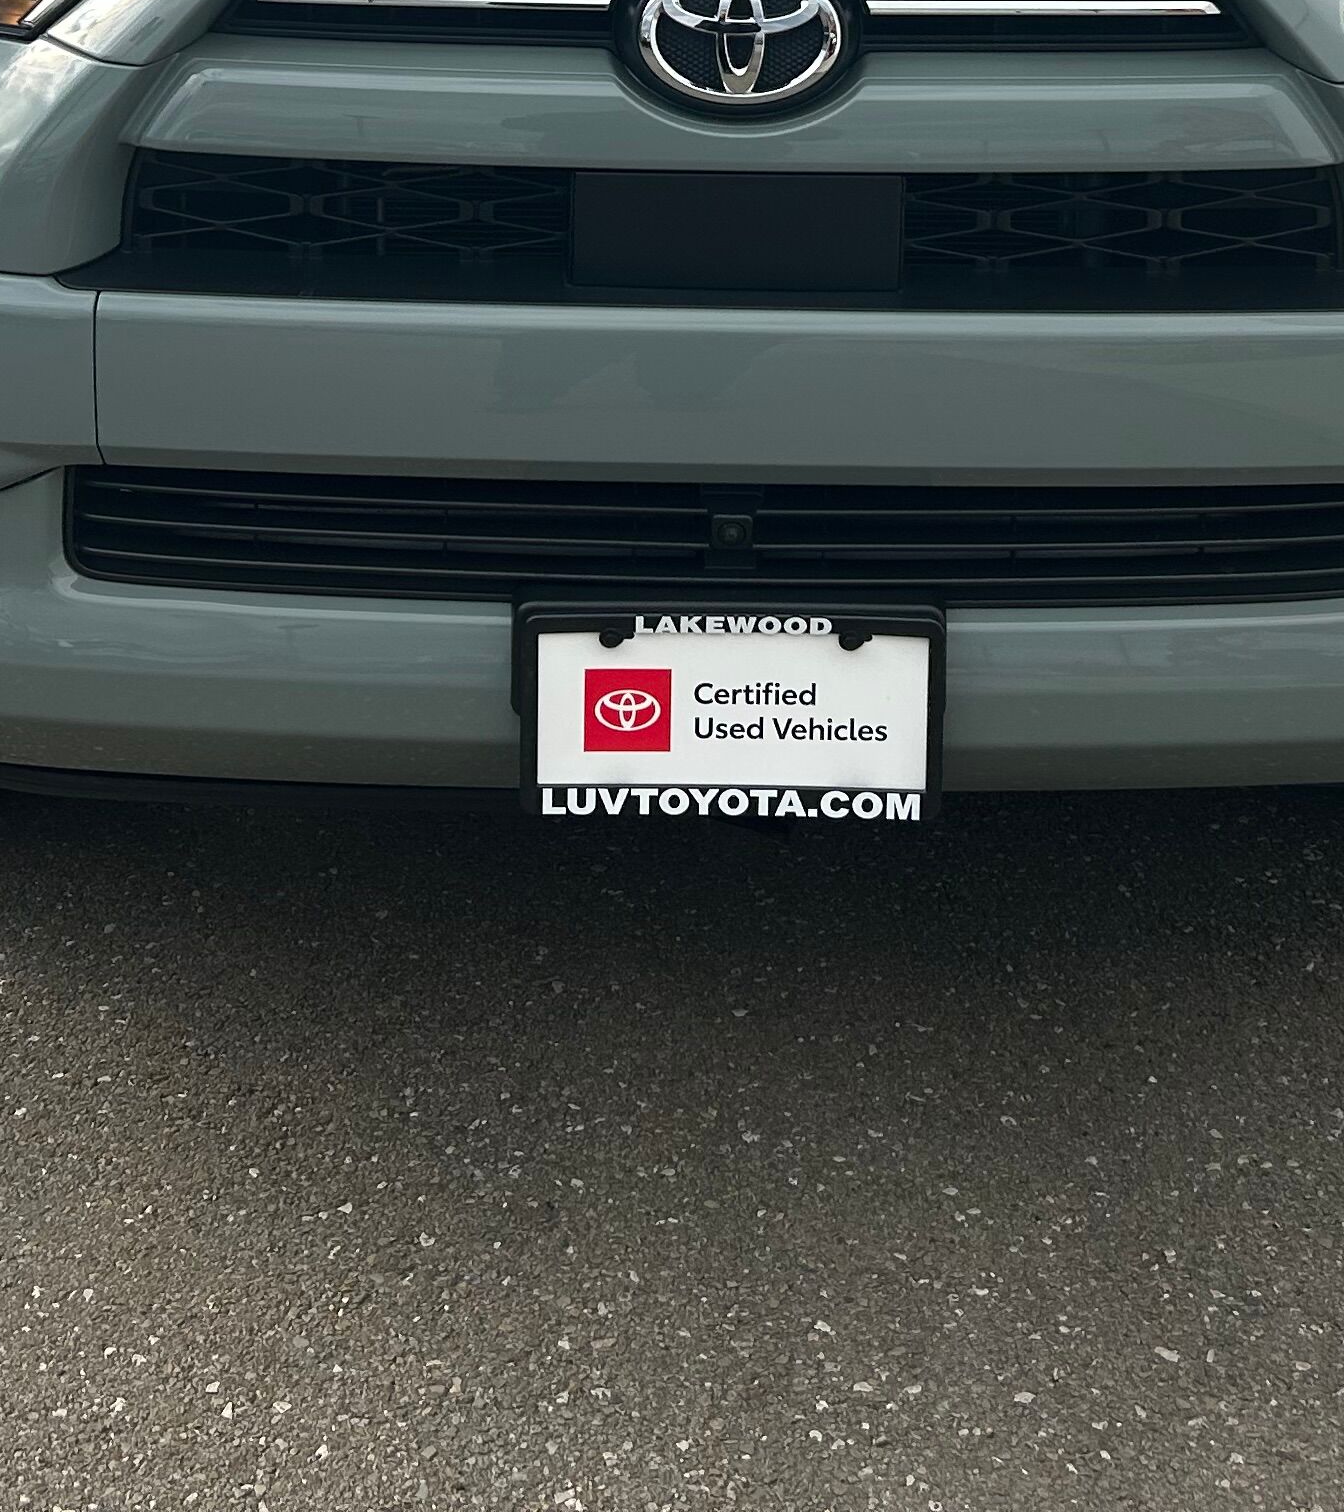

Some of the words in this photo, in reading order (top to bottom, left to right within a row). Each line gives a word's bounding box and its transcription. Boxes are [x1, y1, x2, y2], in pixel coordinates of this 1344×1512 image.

[634, 615, 833, 636] LAKEWOOD
[693, 682, 817, 706] Certified
[693, 716, 764, 740] Used
[773, 717, 888, 742] Vehicles
[541, 787, 921, 821] LUVTOYOTA.COM
